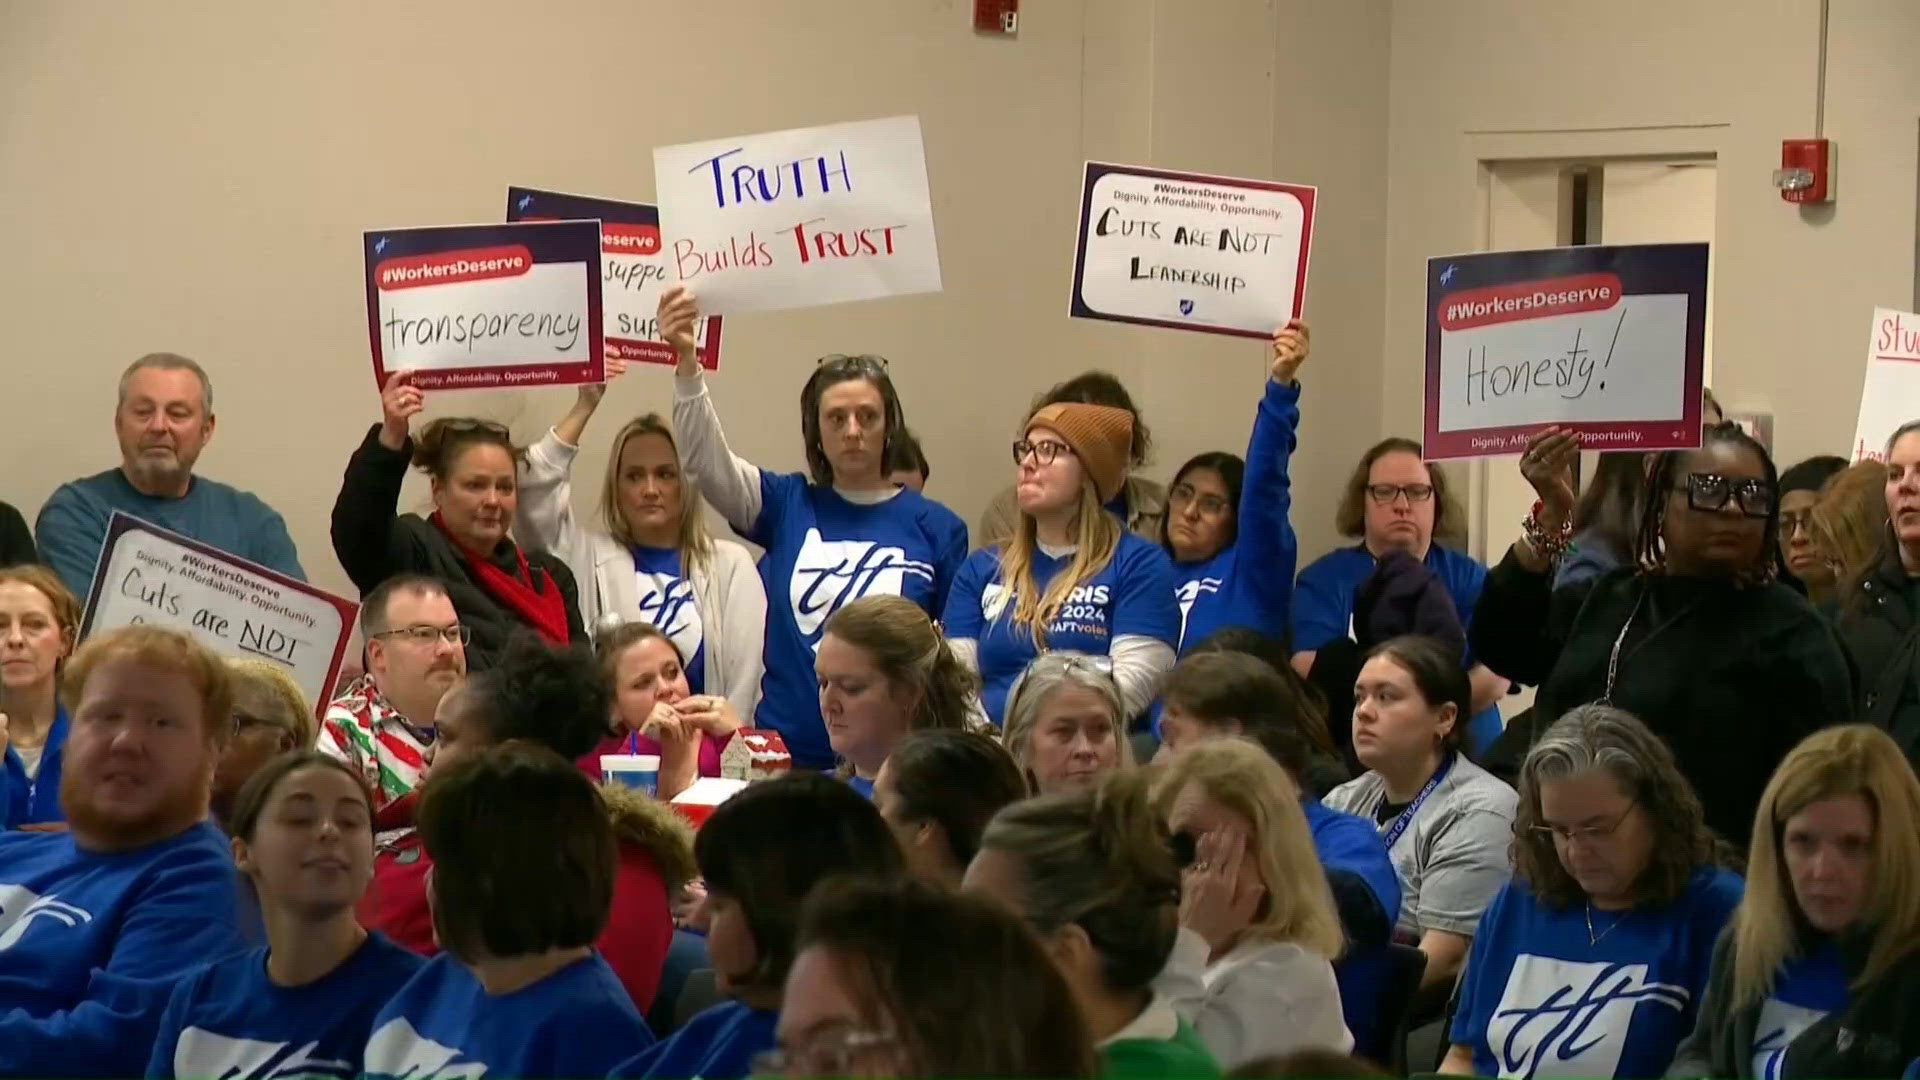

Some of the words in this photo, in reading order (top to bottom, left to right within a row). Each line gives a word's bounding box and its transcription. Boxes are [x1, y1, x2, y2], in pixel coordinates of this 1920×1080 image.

[688, 147, 851, 208] TRUTH
[1154, 183, 1246, 202] #WorkersDeserve
[1113, 190, 1151, 204] Dignity.
[1153, 195, 1219, 213] Affordability.
[1221, 203, 1283, 220] Opportunity.
[674, 231, 773, 280] Builds
[775, 218, 907, 264] TRUST
[1096, 206, 1161, 240] CUTS
[1218, 226, 1283, 255] NOT
[382, 255, 524, 284] #WorkersDeserve
[1130, 256, 1246, 294] LEADERSHIP
[1446, 284, 1611, 322] #WorkersDeserve
[385, 308, 580, 352] transparency
[621, 345, 674, 361] Opportunity.
[1466, 307, 1627, 406] Honesty!
[411, 375, 444, 387] Dignity.
[446, 372, 502, 386] Affordability.
[504, 369, 559, 382] Opportunity.
[1471, 436, 1509, 450] Dignity.
[136, 549, 176, 574] Dignity.
[179, 566, 247, 602] Affordability.
[251, 593, 318, 628] Opportunity.
[181, 554, 281, 600] #WorkersDeserve
[120, 566, 186, 616] Cuts
[192, 608, 230, 638] are
[239, 619, 313, 662] NOT
[1062, 605, 1106, 623] 2024
